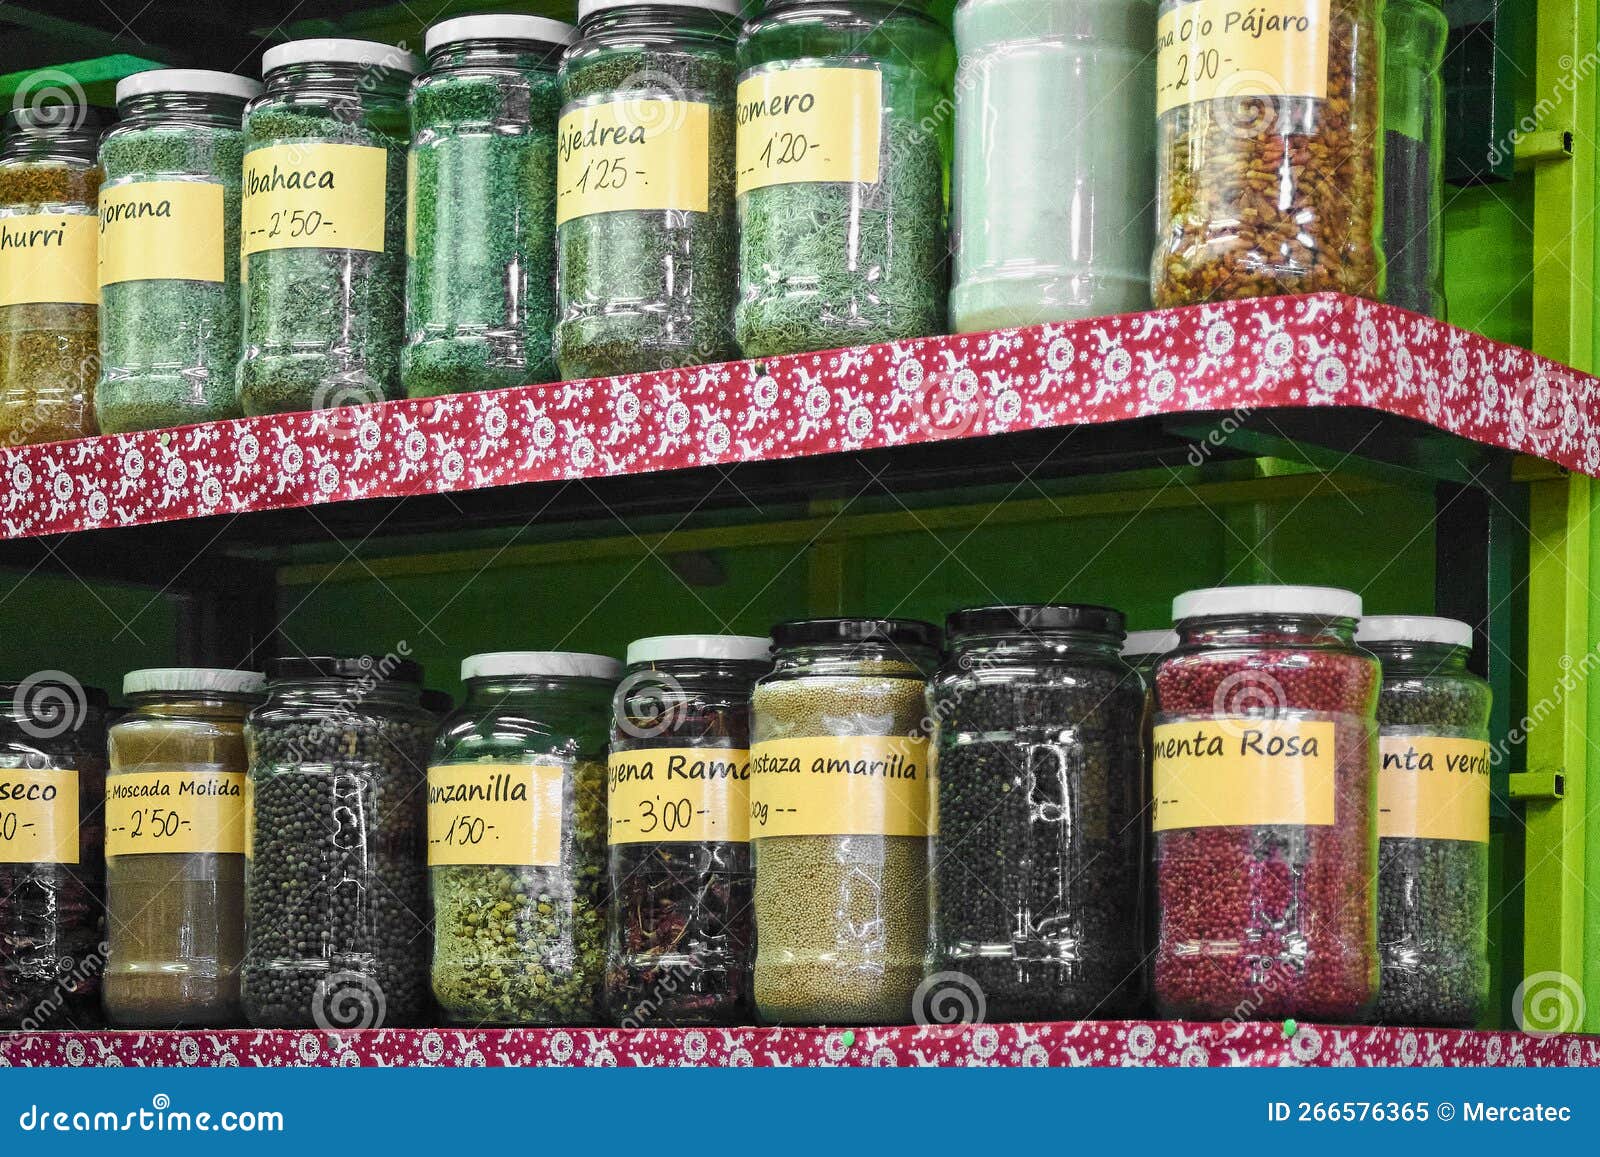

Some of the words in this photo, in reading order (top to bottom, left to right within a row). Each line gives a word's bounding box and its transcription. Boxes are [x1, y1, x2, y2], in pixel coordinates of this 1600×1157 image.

[1225, 8, 1309, 38] Pájaro
[559, 118, 646, 162] Ajedrea
[100, 199, 171, 234] jorana
[1, 222, 66, 250] hurri
[1240, 730, 1319, 757] Rosa
[608, 762, 654, 792] yena
[752, 753, 801, 775] ostaza
[811, 754, 917, 780] amarilla
[112, 780, 170, 799] Moscada
[179, 779, 240, 796] Molida
